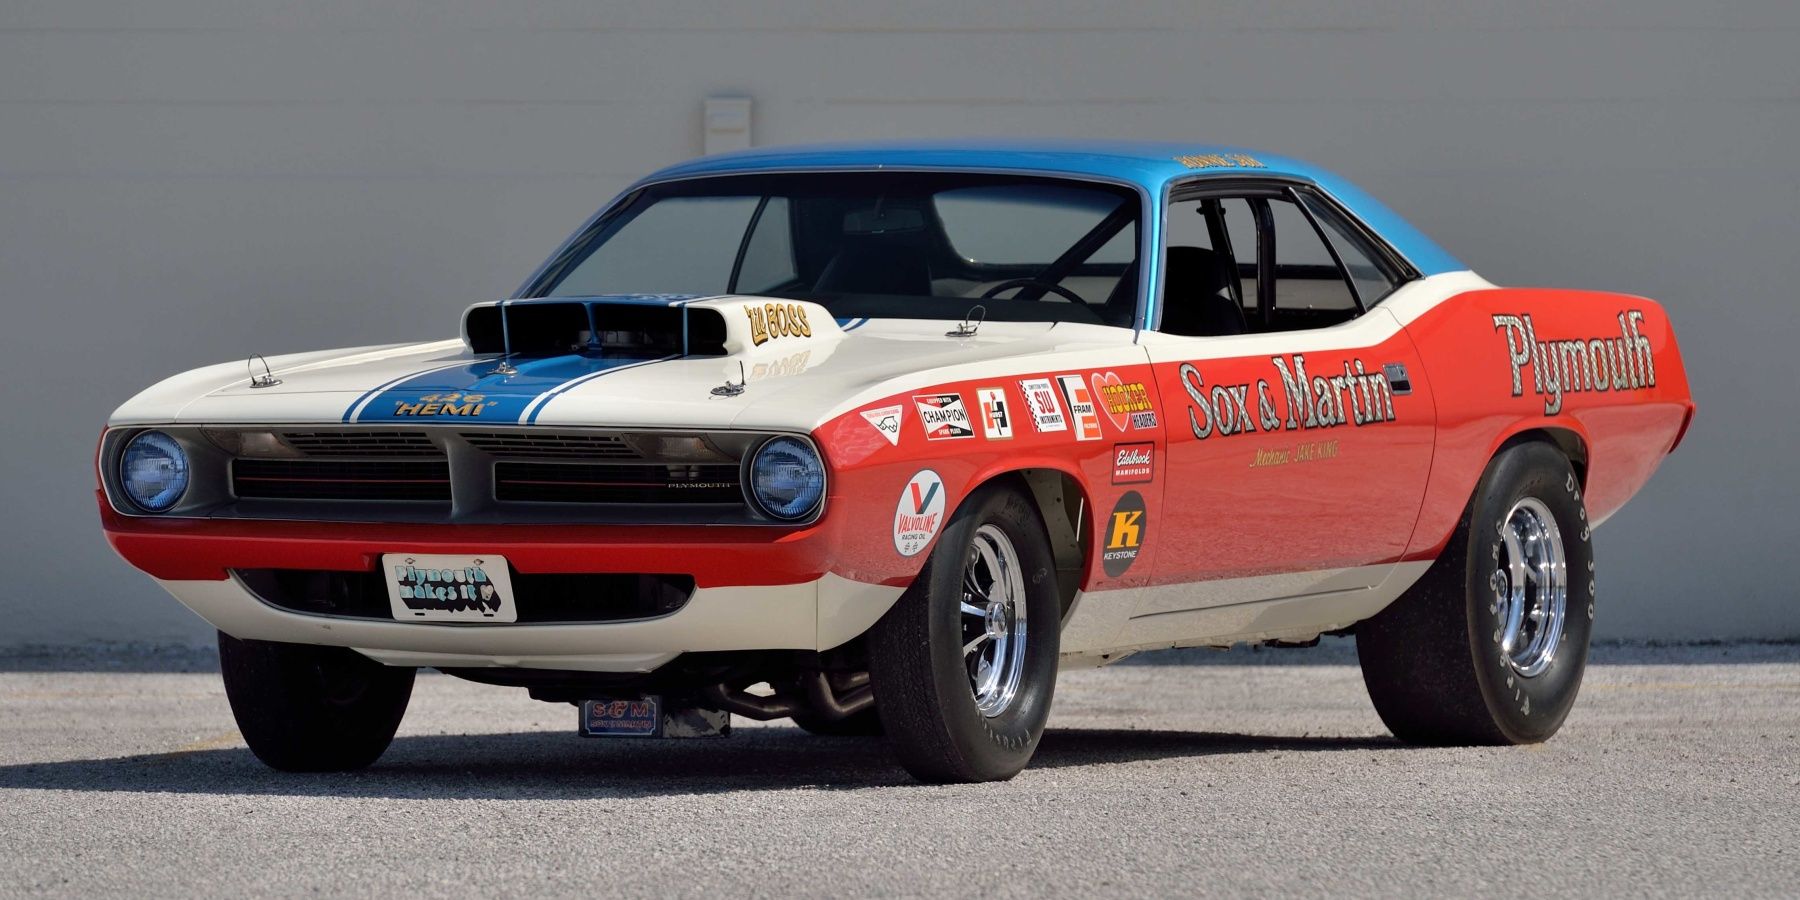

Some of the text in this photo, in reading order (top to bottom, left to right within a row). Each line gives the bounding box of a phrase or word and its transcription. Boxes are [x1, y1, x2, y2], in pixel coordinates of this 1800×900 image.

[765, 303, 811, 339] BOSS
[1492, 309, 1656, 417] Plymouth
[419, 393, 487, 403] 426
[1034, 390, 1055, 414] SW
[1102, 382, 1153, 414] HOOKER
[1179, 354, 1396, 440] Sox & Martin
[923, 408, 966, 424] CHAMPION
[1073, 405, 1092, 414] FRAM
[1132, 412, 1157, 429] HEADERS
[1116, 448, 1151, 467] Edelbrock
[1294, 442, 1316, 462] JAKE
[1317, 439, 1339, 459] KING
[1115, 467, 1150, 476] MANIFOLDS
[898, 511, 938, 535] VALVOLINE
[1107, 510, 1143, 549] K
[902, 533, 918, 541] RACING
[1104, 550, 1138, 560] KEYSTONE
[592, 703, 606, 718] S
[631, 703, 649, 718] M
